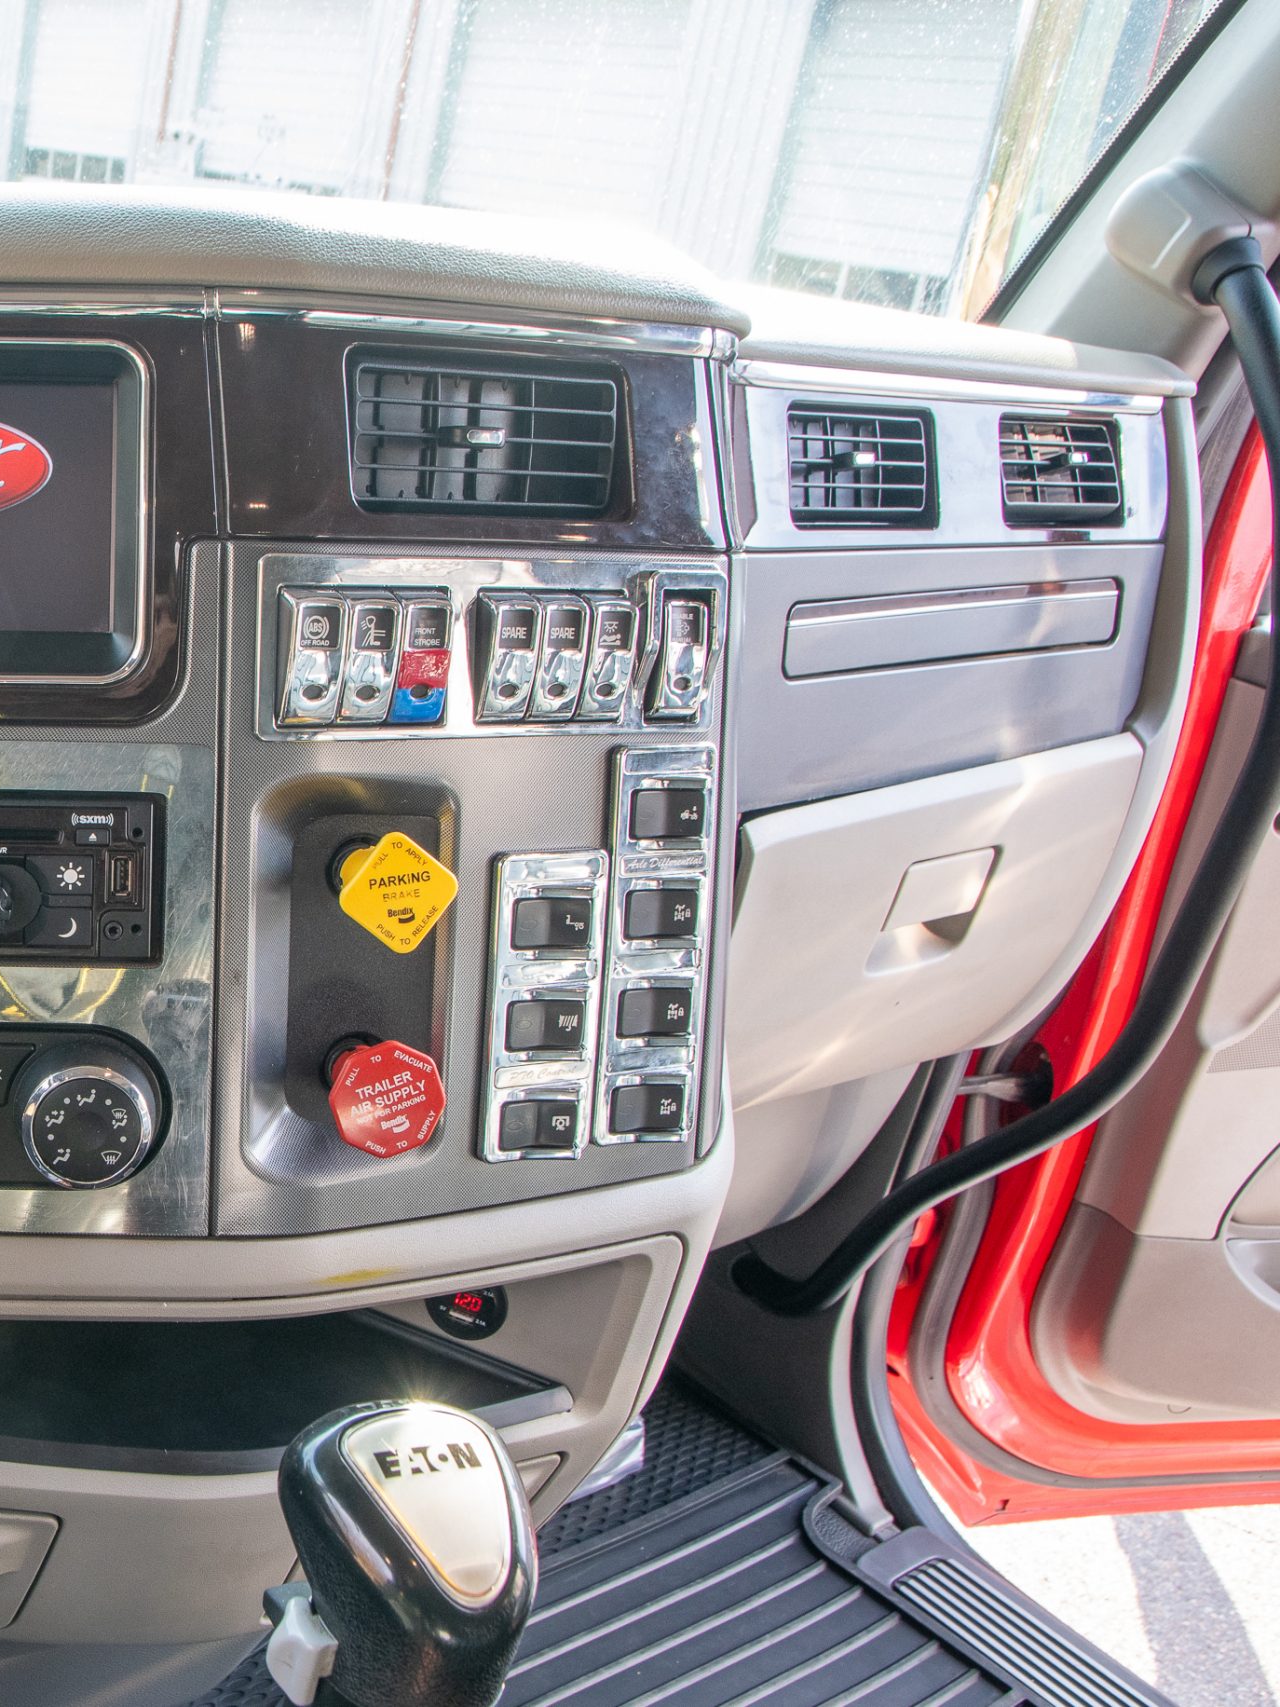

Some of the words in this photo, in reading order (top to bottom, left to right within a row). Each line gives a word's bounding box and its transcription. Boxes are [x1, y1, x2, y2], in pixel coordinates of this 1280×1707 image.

[308, 622, 323, 633] ABS
[414, 627, 436, 635] FRONT
[501, 626, 527, 639] SPARE
[550, 627, 576, 639] SPARE
[414, 638, 441, 646] STROBE
[392, 842, 403, 850] TO
[406, 848, 428, 866] APPLY
[368, 870, 431, 890] PARKING
[382, 888, 420, 902] BRAKE
[387, 906, 414, 918] Bendix
[376, 923, 396, 941] PUSH
[400, 938, 411, 946] TO
[412, 905, 439, 937] RELEASE
[345, 1066, 360, 1086] PULL
[370, 1054, 382, 1064] TO
[394, 1050, 433, 1074] EVACUATE
[355, 1070, 413, 1100] TRAILER
[350, 1100, 372, 1117] AIR
[374, 1080, 426, 1108] SUPPLY
[374, 1108, 391, 1118] FOR
[392, 1094, 426, 1113] PARKING
[365, 1140, 386, 1154] PUSH
[396, 1140, 408, 1149] TO
[417, 1110, 436, 1140] SUPPLY
